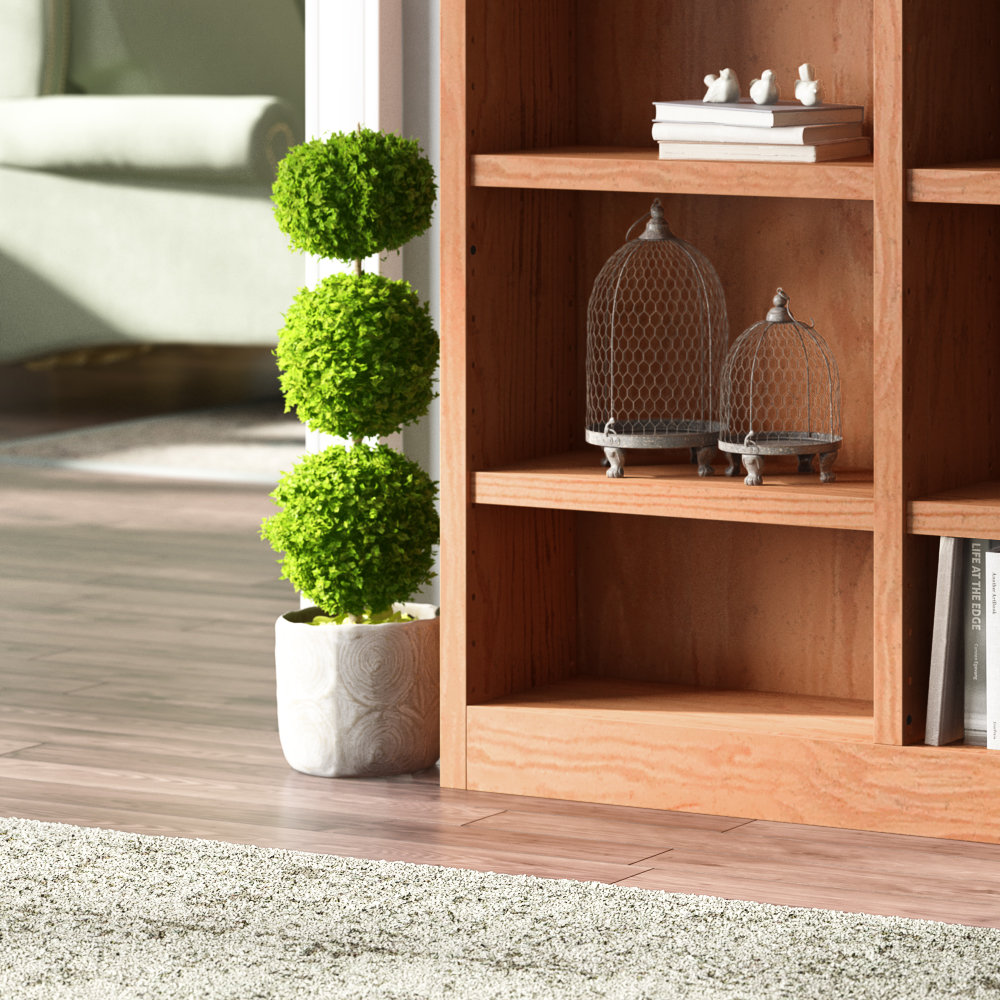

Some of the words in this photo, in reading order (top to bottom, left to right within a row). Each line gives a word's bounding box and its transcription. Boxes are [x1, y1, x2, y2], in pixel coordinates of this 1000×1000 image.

[971, 542, 981, 564] LIFE
[971, 565, 981, 579] AT
[971, 581, 981, 602] THE
[971, 602, 981, 631] EDGE
